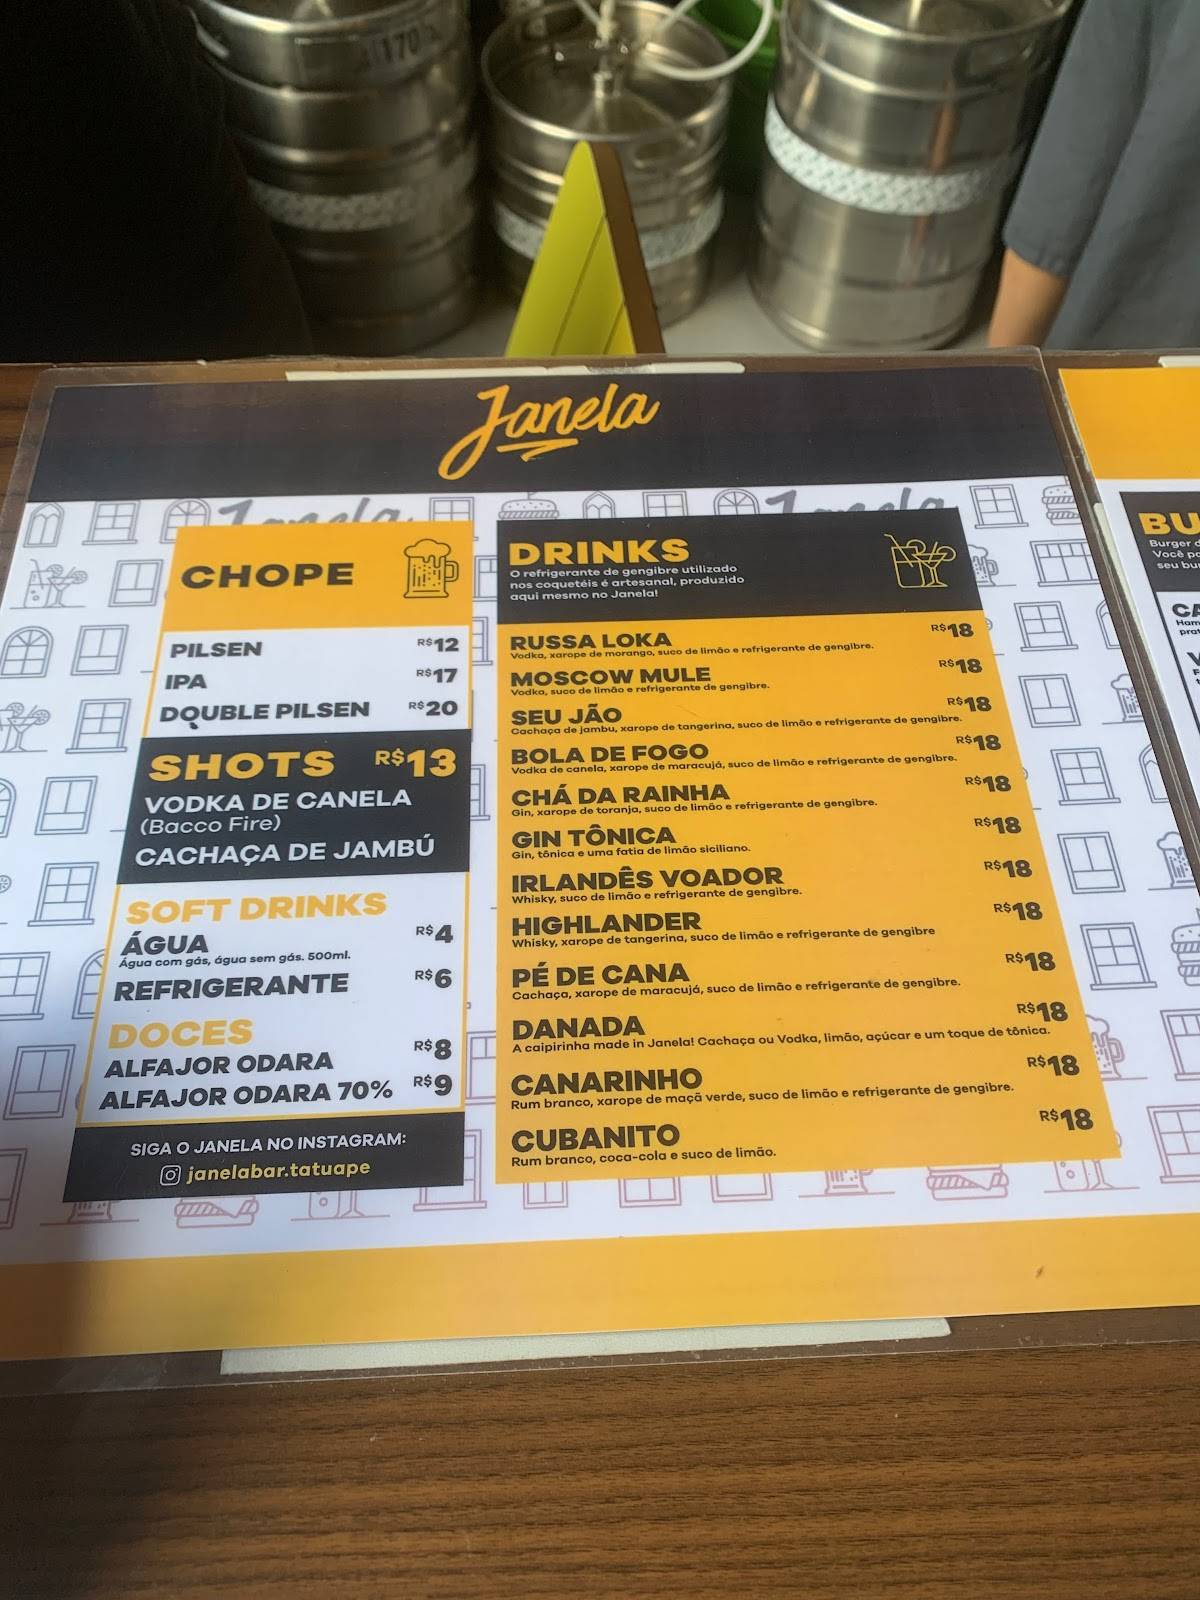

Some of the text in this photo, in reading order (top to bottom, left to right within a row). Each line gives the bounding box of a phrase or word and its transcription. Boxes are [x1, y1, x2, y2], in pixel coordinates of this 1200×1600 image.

[438, 384, 659, 480] Janela
[510, 539, 688, 565] DRINKS
[1149, 539, 1191, 549] Burger
[1152, 550, 1185, 558] Você
[182, 563, 353, 588] CHOPE
[510, 564, 737, 578] O refrigerante de gengibre utilizado
[510, 576, 744, 590] nos coquetéis é artesanal, produzido
[510, 589, 658, 601] aqui mesmo no Janela!
[171, 642, 262, 658] PILSEN
[510, 651, 546, 660] Vodka,
[550, 651, 586, 660] xarope
[589, 649, 602, 658] de
[605, 649, 655, 658] morango,
[685, 647, 698, 655] de
[701, 646, 730, 655] limão
[742, 644, 805, 653] refrigerante
[808, 643, 821, 651] de
[824, 642, 874, 651] gengibre.
[511, 635, 596, 650] RUSSA
[602, 633, 672, 648] LOKA
[166, 674, 207, 689] IPA
[511, 670, 633, 686] MOSCOW
[640, 668, 710, 683] MULE
[160, 704, 270, 722] DOUBLE
[276, 702, 369, 718] PILSEN
[512, 710, 561, 726] SEU
[568, 704, 622, 724] JÃO
[149, 751, 334, 781] SHOTS
[512, 748, 584, 764] BOLA
[591, 746, 625, 762] DE
[632, 744, 708, 760] FOGO
[145, 790, 411, 814] VODKA DE CANELA
[512, 784, 572, 806] CHÁ
[578, 788, 616, 804] DA
[623, 784, 730, 802] RAINHA
[141, 814, 280, 835] (Bacco Fire)
[512, 831, 560, 848] GIN
[568, 824, 676, 846] TÔNICA
[136, 835, 434, 866] CACHAÇA DE JAMBÚ
[512, 866, 653, 893] IRLANDÊS
[660, 867, 784, 887] VOADOR
[126, 892, 386, 925] SOFT DRINKS
[512, 912, 702, 936] HIGHLANDER
[120, 931, 208, 956] ÁGUA
[119, 950, 350, 969] Água com gás, água sem gás. 500ml.
[114, 973, 348, 1001] REFRIGERANTE
[513, 962, 549, 988] PÉ
[557, 966, 594, 986] DE
[602, 963, 690, 984] CANA
[109, 1019, 252, 1048] DOCES
[512, 1026, 1050, 1053] A caipirinha made in Janela! Cachaça ou Vodka, limão, açúcar e um toque de tônica.
[513, 1016, 645, 1040] DANADA
[104, 1056, 230, 1078] ALFAJOR
[237, 1052, 333, 1073] ODARA
[512, 1068, 702, 1096] CANARINHO
[98, 1088, 226, 1111] ALFAJOR
[234, 1083, 331, 1104] ODARA
[338, 1080, 392, 1100] 70%
[512, 1082, 1014, 1109] Rum branco, xarope de maçã verde, suco de limão e refrigerante de gengibre.
[131, 1133, 406, 1156] SIGA O JANELA NO INSTAGRAM:
[512, 1124, 680, 1152] CUBANITO
[512, 1147, 776, 1166] Rum branco, coca-cola e suco de limão.
[186, 1162, 370, 1184] janelabar.tatuape
